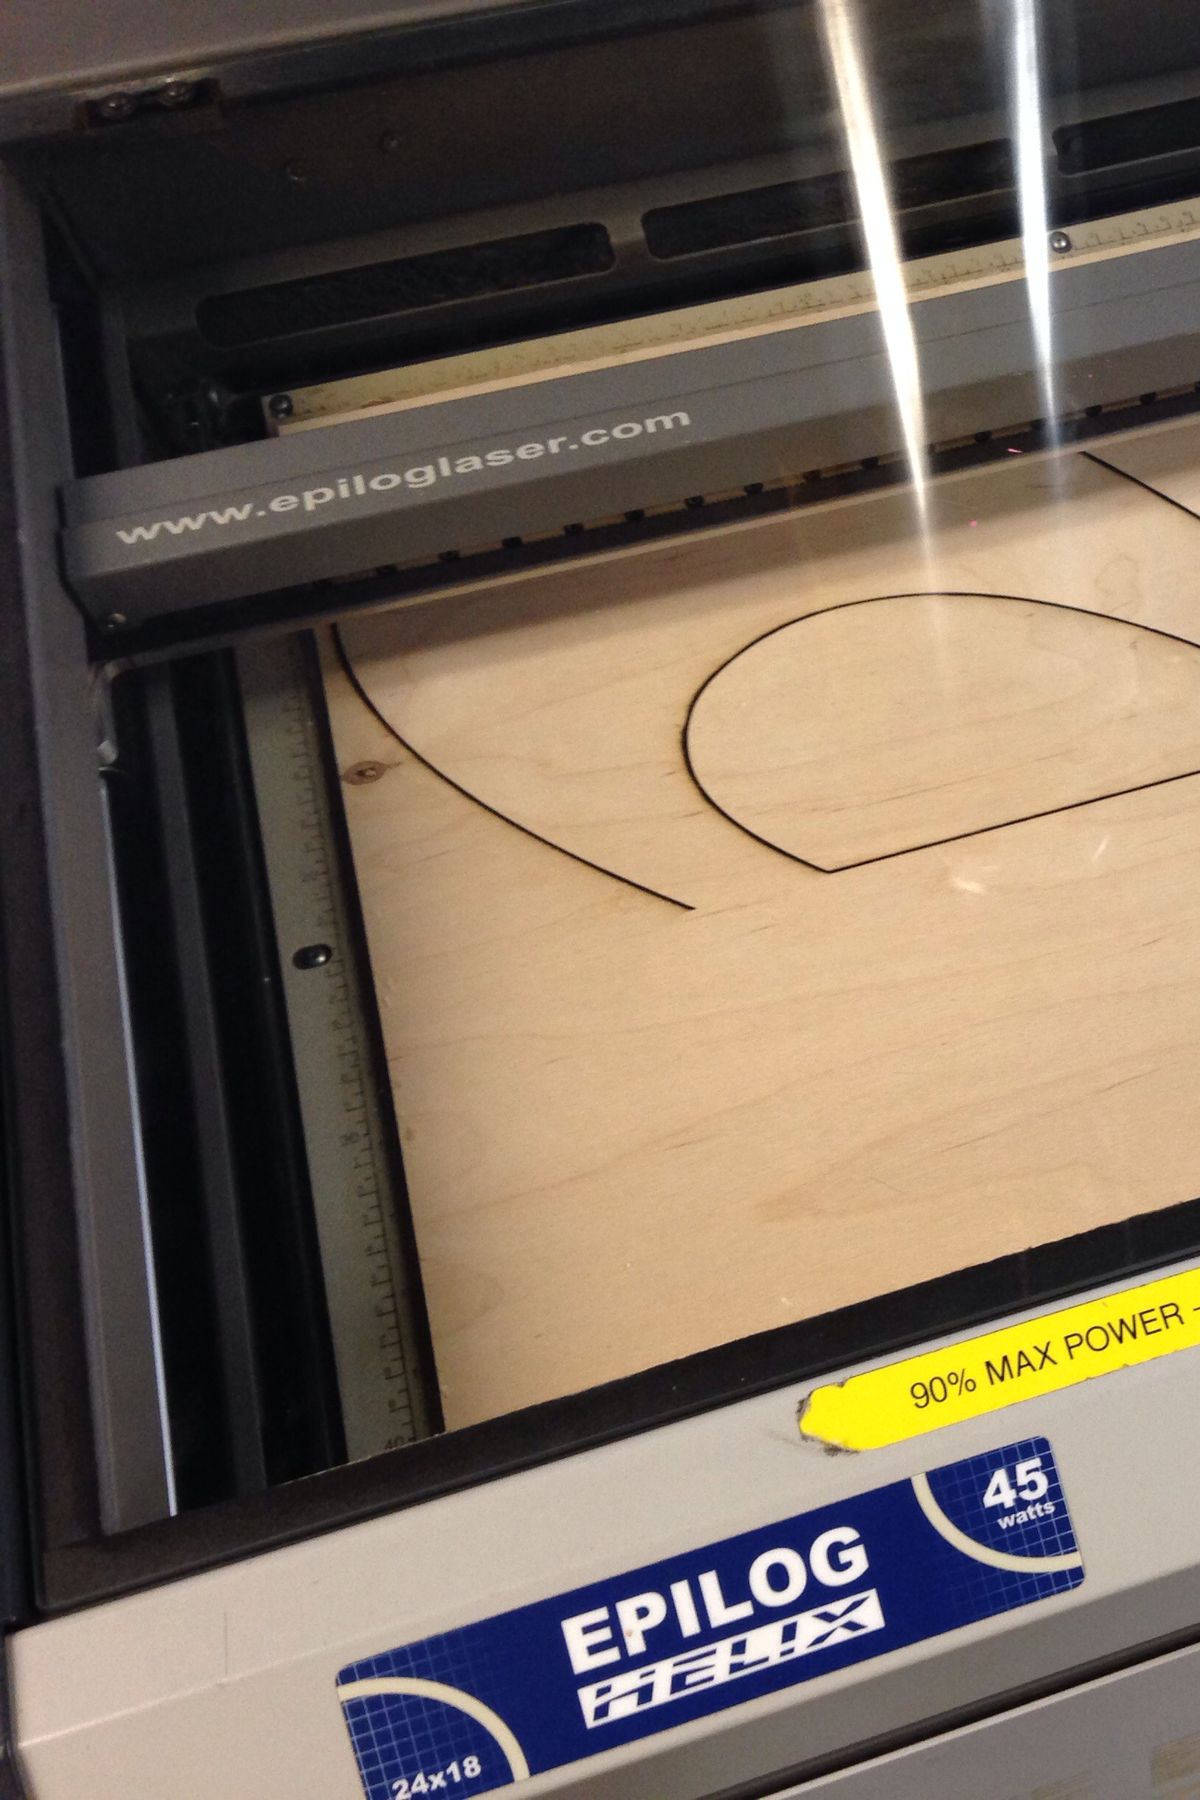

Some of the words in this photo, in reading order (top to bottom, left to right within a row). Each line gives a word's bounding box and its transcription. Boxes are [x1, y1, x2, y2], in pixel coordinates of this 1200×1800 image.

[115, 409, 692, 545] www.epiloglaser.com
[910, 1371, 978, 1410] 90%
[985, 1342, 1057, 1387] MAX
[1064, 1302, 1186, 1361] POWER
[982, 1456, 1051, 1509] 45
[997, 1498, 1056, 1531] watts
[560, 1525, 870, 1675] EPILOG
[577, 1588, 885, 1729] HELIX
[391, 1755, 482, 1800] 24x18
